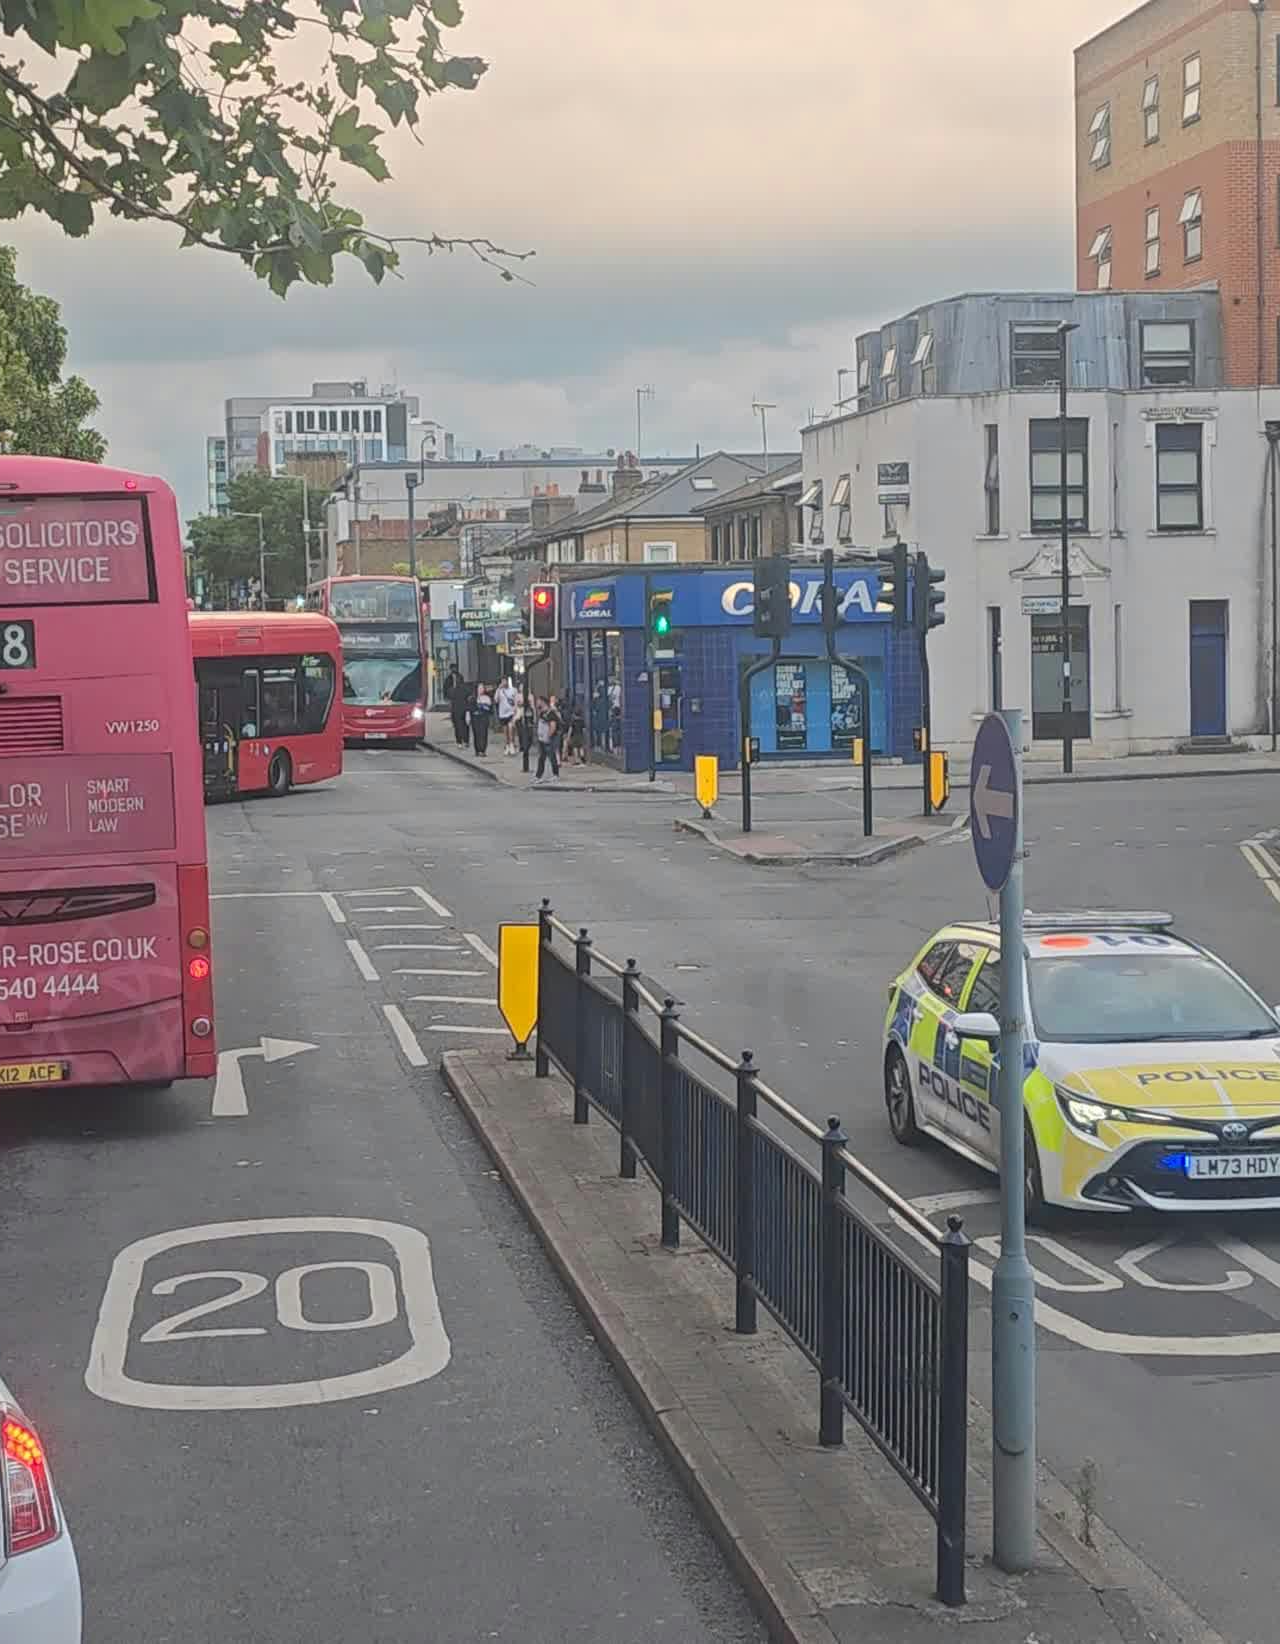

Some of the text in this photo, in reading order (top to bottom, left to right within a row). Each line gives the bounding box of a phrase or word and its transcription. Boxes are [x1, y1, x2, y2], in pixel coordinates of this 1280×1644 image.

[4, 556, 111, 586] SERVICE
[105, 719, 160, 734] VW1250
[87, 778, 130, 794] SMART
[88, 797, 144, 814] MODERN
[88, 817, 119, 833] LAW
[43, 973, 100, 998] 4444
[28, 1065, 57, 1080] ACF
[918, 1060, 993, 1134] POLICE
[1196, 1156, 1280, 1176] LM73 HDY
[140, 1260, 399, 1343] 20
